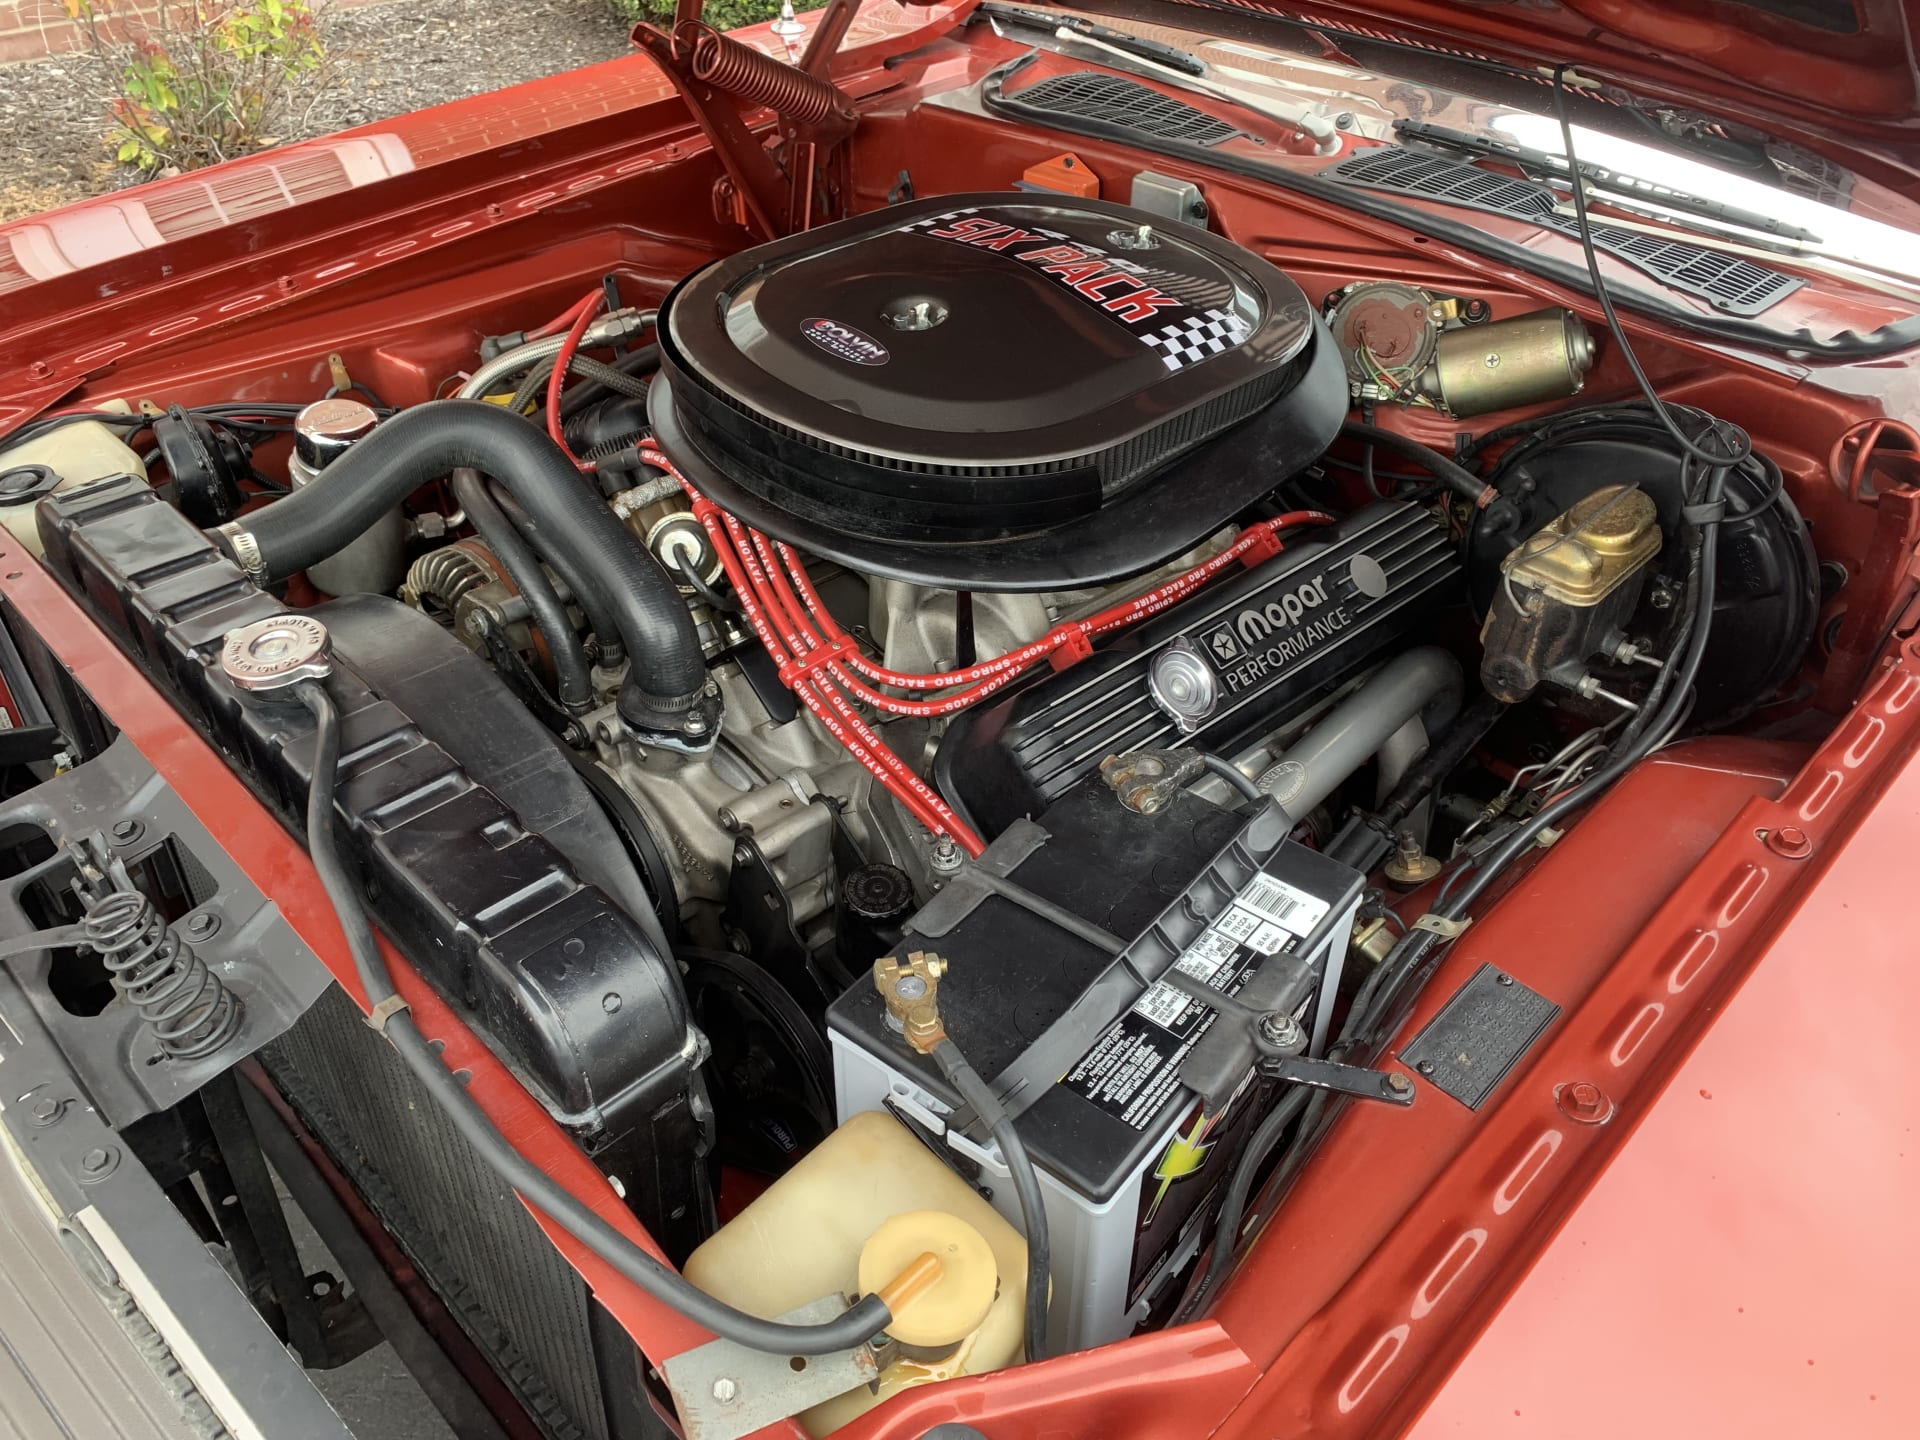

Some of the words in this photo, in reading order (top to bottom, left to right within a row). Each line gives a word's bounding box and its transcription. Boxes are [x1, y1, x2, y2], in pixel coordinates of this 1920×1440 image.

[928, 216, 1047, 252] SIX
[1013, 243, 1184, 324] PACK
[814, 320, 886, 359] COLVIN
[641, 450, 668, 465] SPIR
[737, 539, 765, 585] TAYLOR
[753, 534, 776, 581] TAYLOR
[1209, 553, 1233, 570] SPIRO
[1188, 567, 1206, 583] PRO
[737, 584, 756, 615] WIRE
[790, 569, 818, 614] TAYLOR
[1161, 580, 1185, 597] RACE
[1134, 594, 1157, 610] WIRE
[754, 618, 777, 651] RACE
[801, 630, 820, 651] IRE
[1226, 606, 1352, 694] PERFORMANCE
[850, 657, 880, 681] WIRE
[971, 658, 1012, 679] SPIRO
[979, 665, 1023, 696] TAYLOR
[889, 676, 926, 688] RACE
[934, 676, 963, 687] PRO
[793, 680, 820, 712] SPIRO
[833, 696, 852, 718] PRO
[856, 689, 880, 707] PRO
[888, 704, 931, 715] SPIRO
[852, 719, 880, 749] SPIRO
[849, 741, 889, 782] TAYLOR
[909, 777, 953, 821] TAYLOR
[1228, 911, 1238, 921] CA
[1236, 914, 1249, 927] CCA
[1174, 1012, 1188, 1027] KEEP
[1184, 1003, 1196, 1016] OUT
